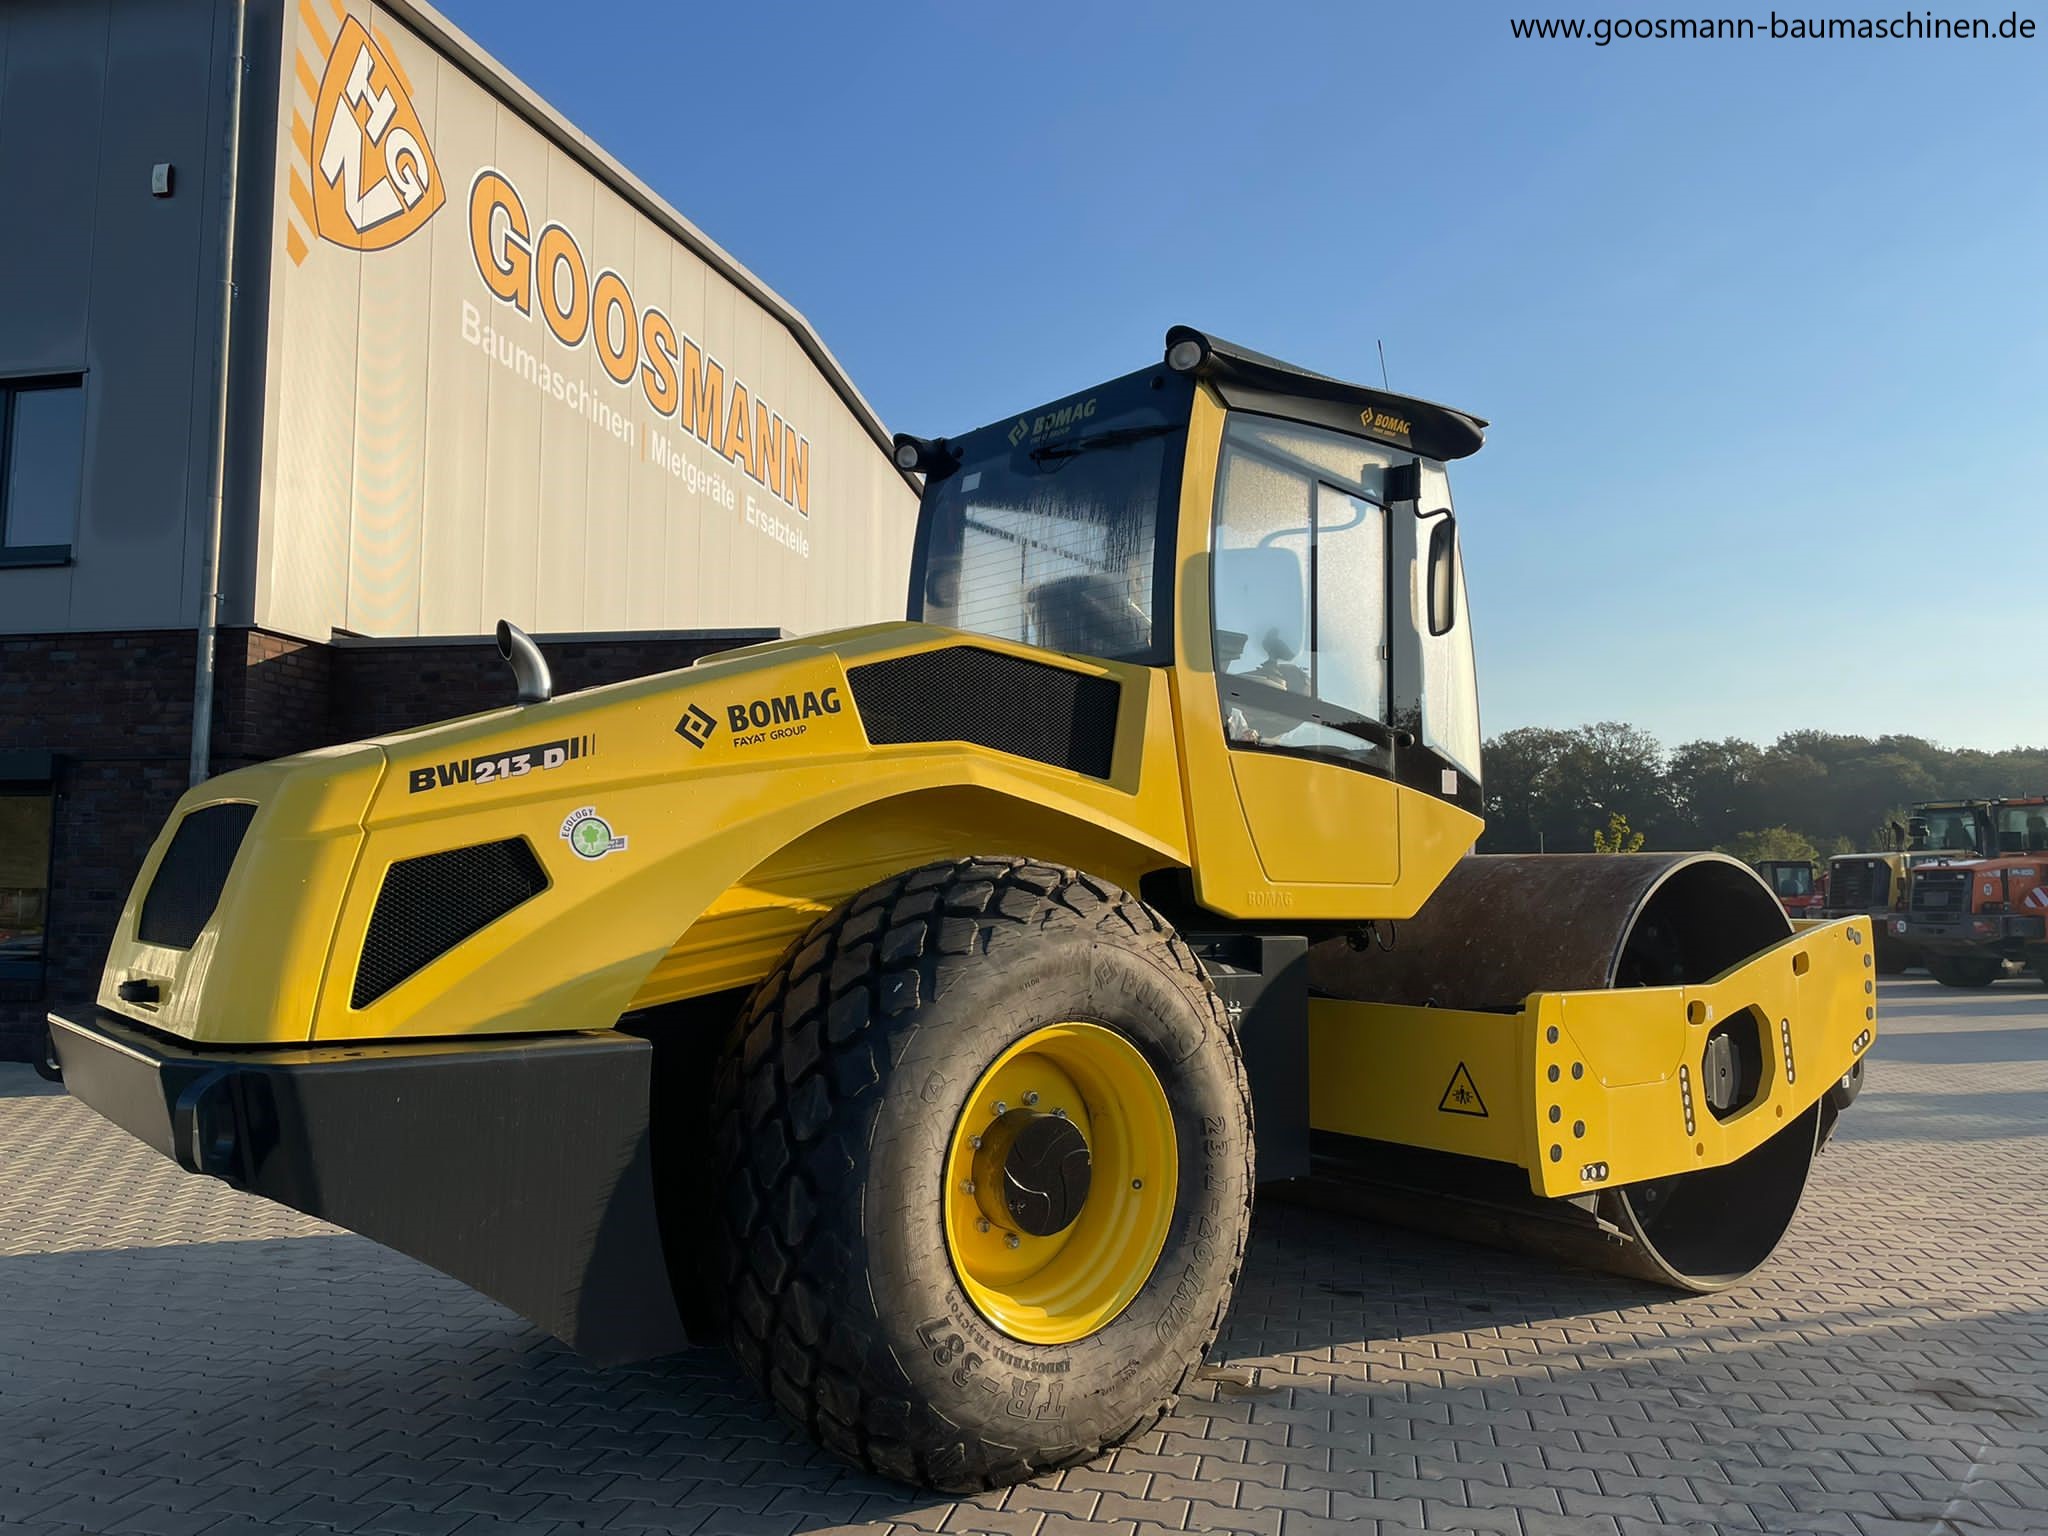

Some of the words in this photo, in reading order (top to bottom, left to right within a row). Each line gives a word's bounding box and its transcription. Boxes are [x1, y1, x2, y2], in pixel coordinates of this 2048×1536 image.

[467, 165, 810, 520] GOOSMANN
[460, 299, 635, 448] Baumaschinen
[651, 429, 735, 512] Mietgeräte
[745, 494, 809, 558] Ersatzteile
[1031, 398, 1096, 436] BOMAG
[1374, 413, 1411, 435] BOMAG
[727, 687, 842, 732] BOMAG
[733, 732, 767, 748] FAYAT
[770, 724, 808, 741] GROUP
[542, 747, 566, 770] D
[561, 807, 595, 838] ECOLOGY
[1247, 890, 1294, 906] BOMAG
